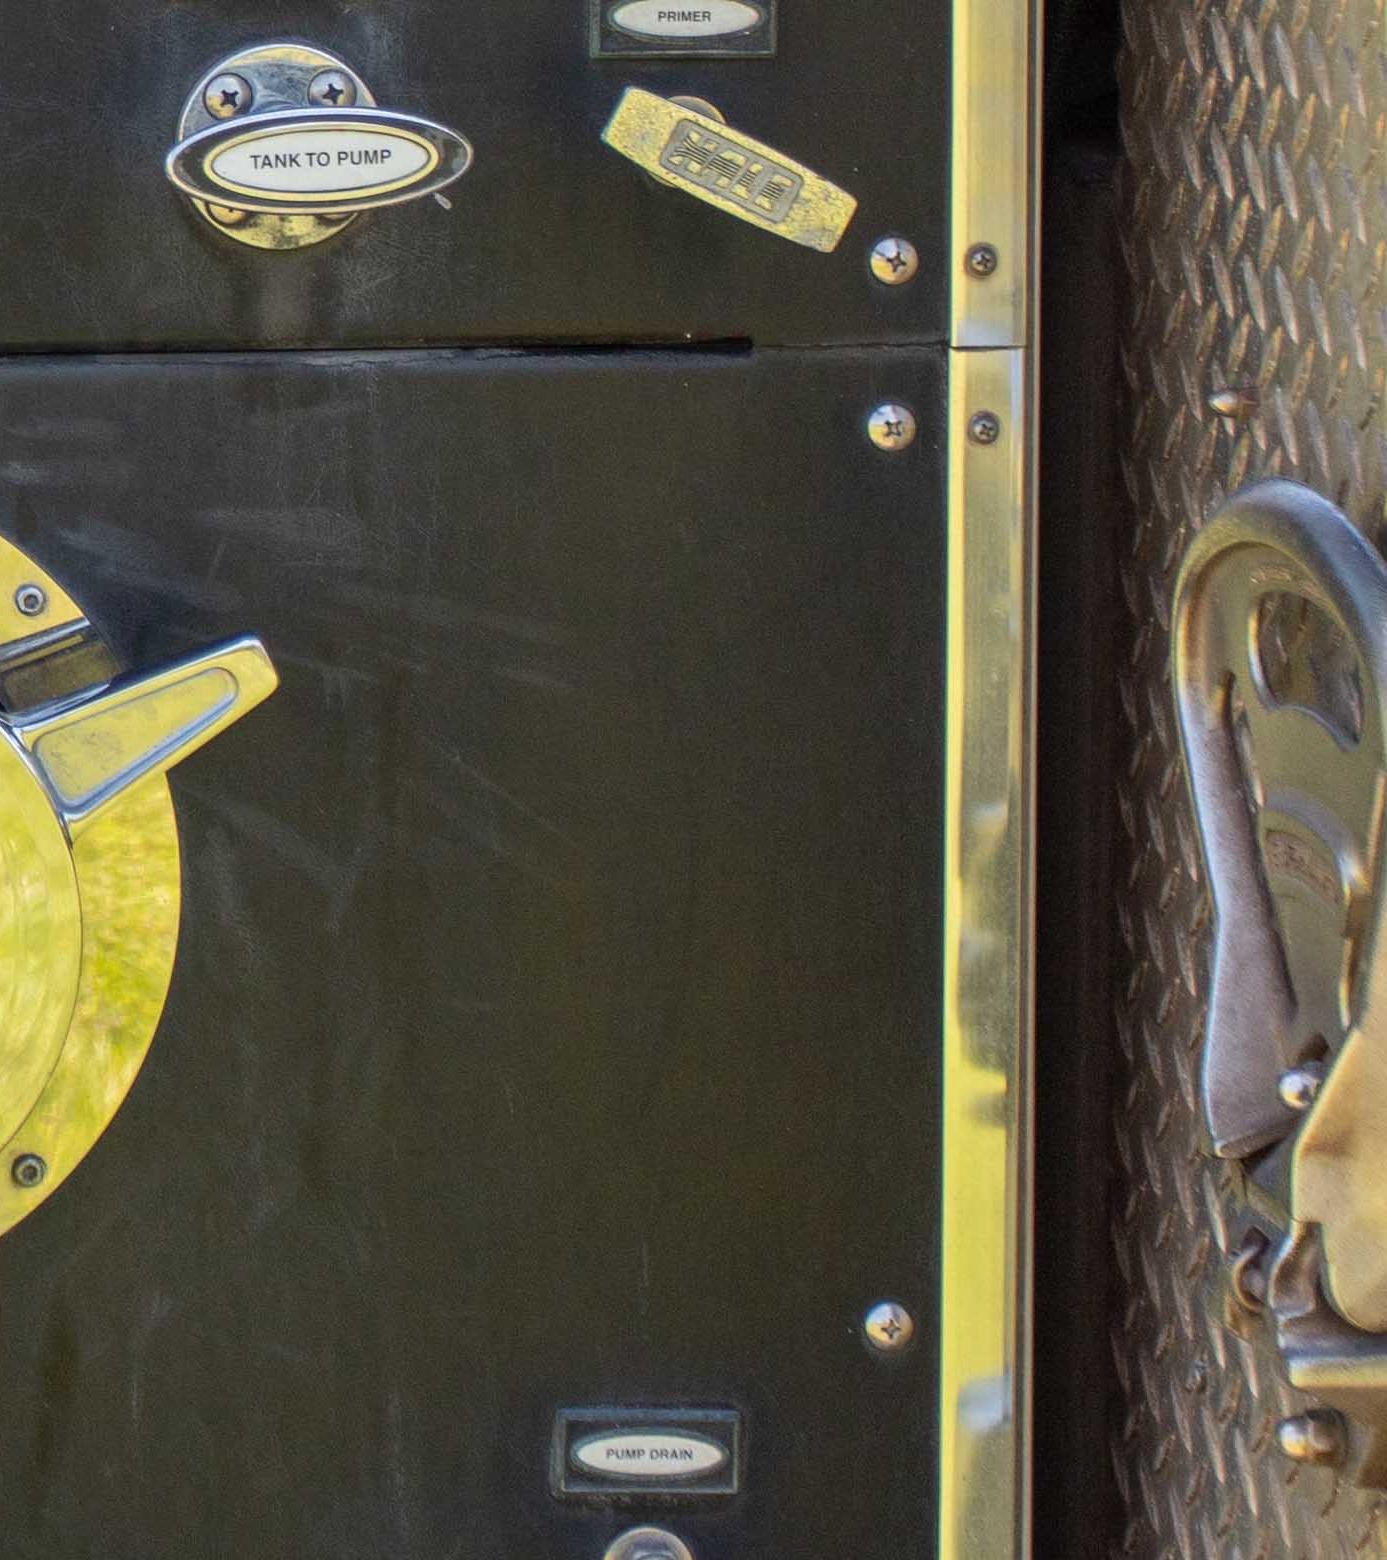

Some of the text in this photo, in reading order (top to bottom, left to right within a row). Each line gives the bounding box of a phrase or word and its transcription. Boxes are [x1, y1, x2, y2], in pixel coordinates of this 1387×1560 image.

[658, 11, 711, 22] PRIMER
[251, 149, 391, 169] TANK TO PUMP
[606, 1448, 693, 1460] PUMP DRAIN
